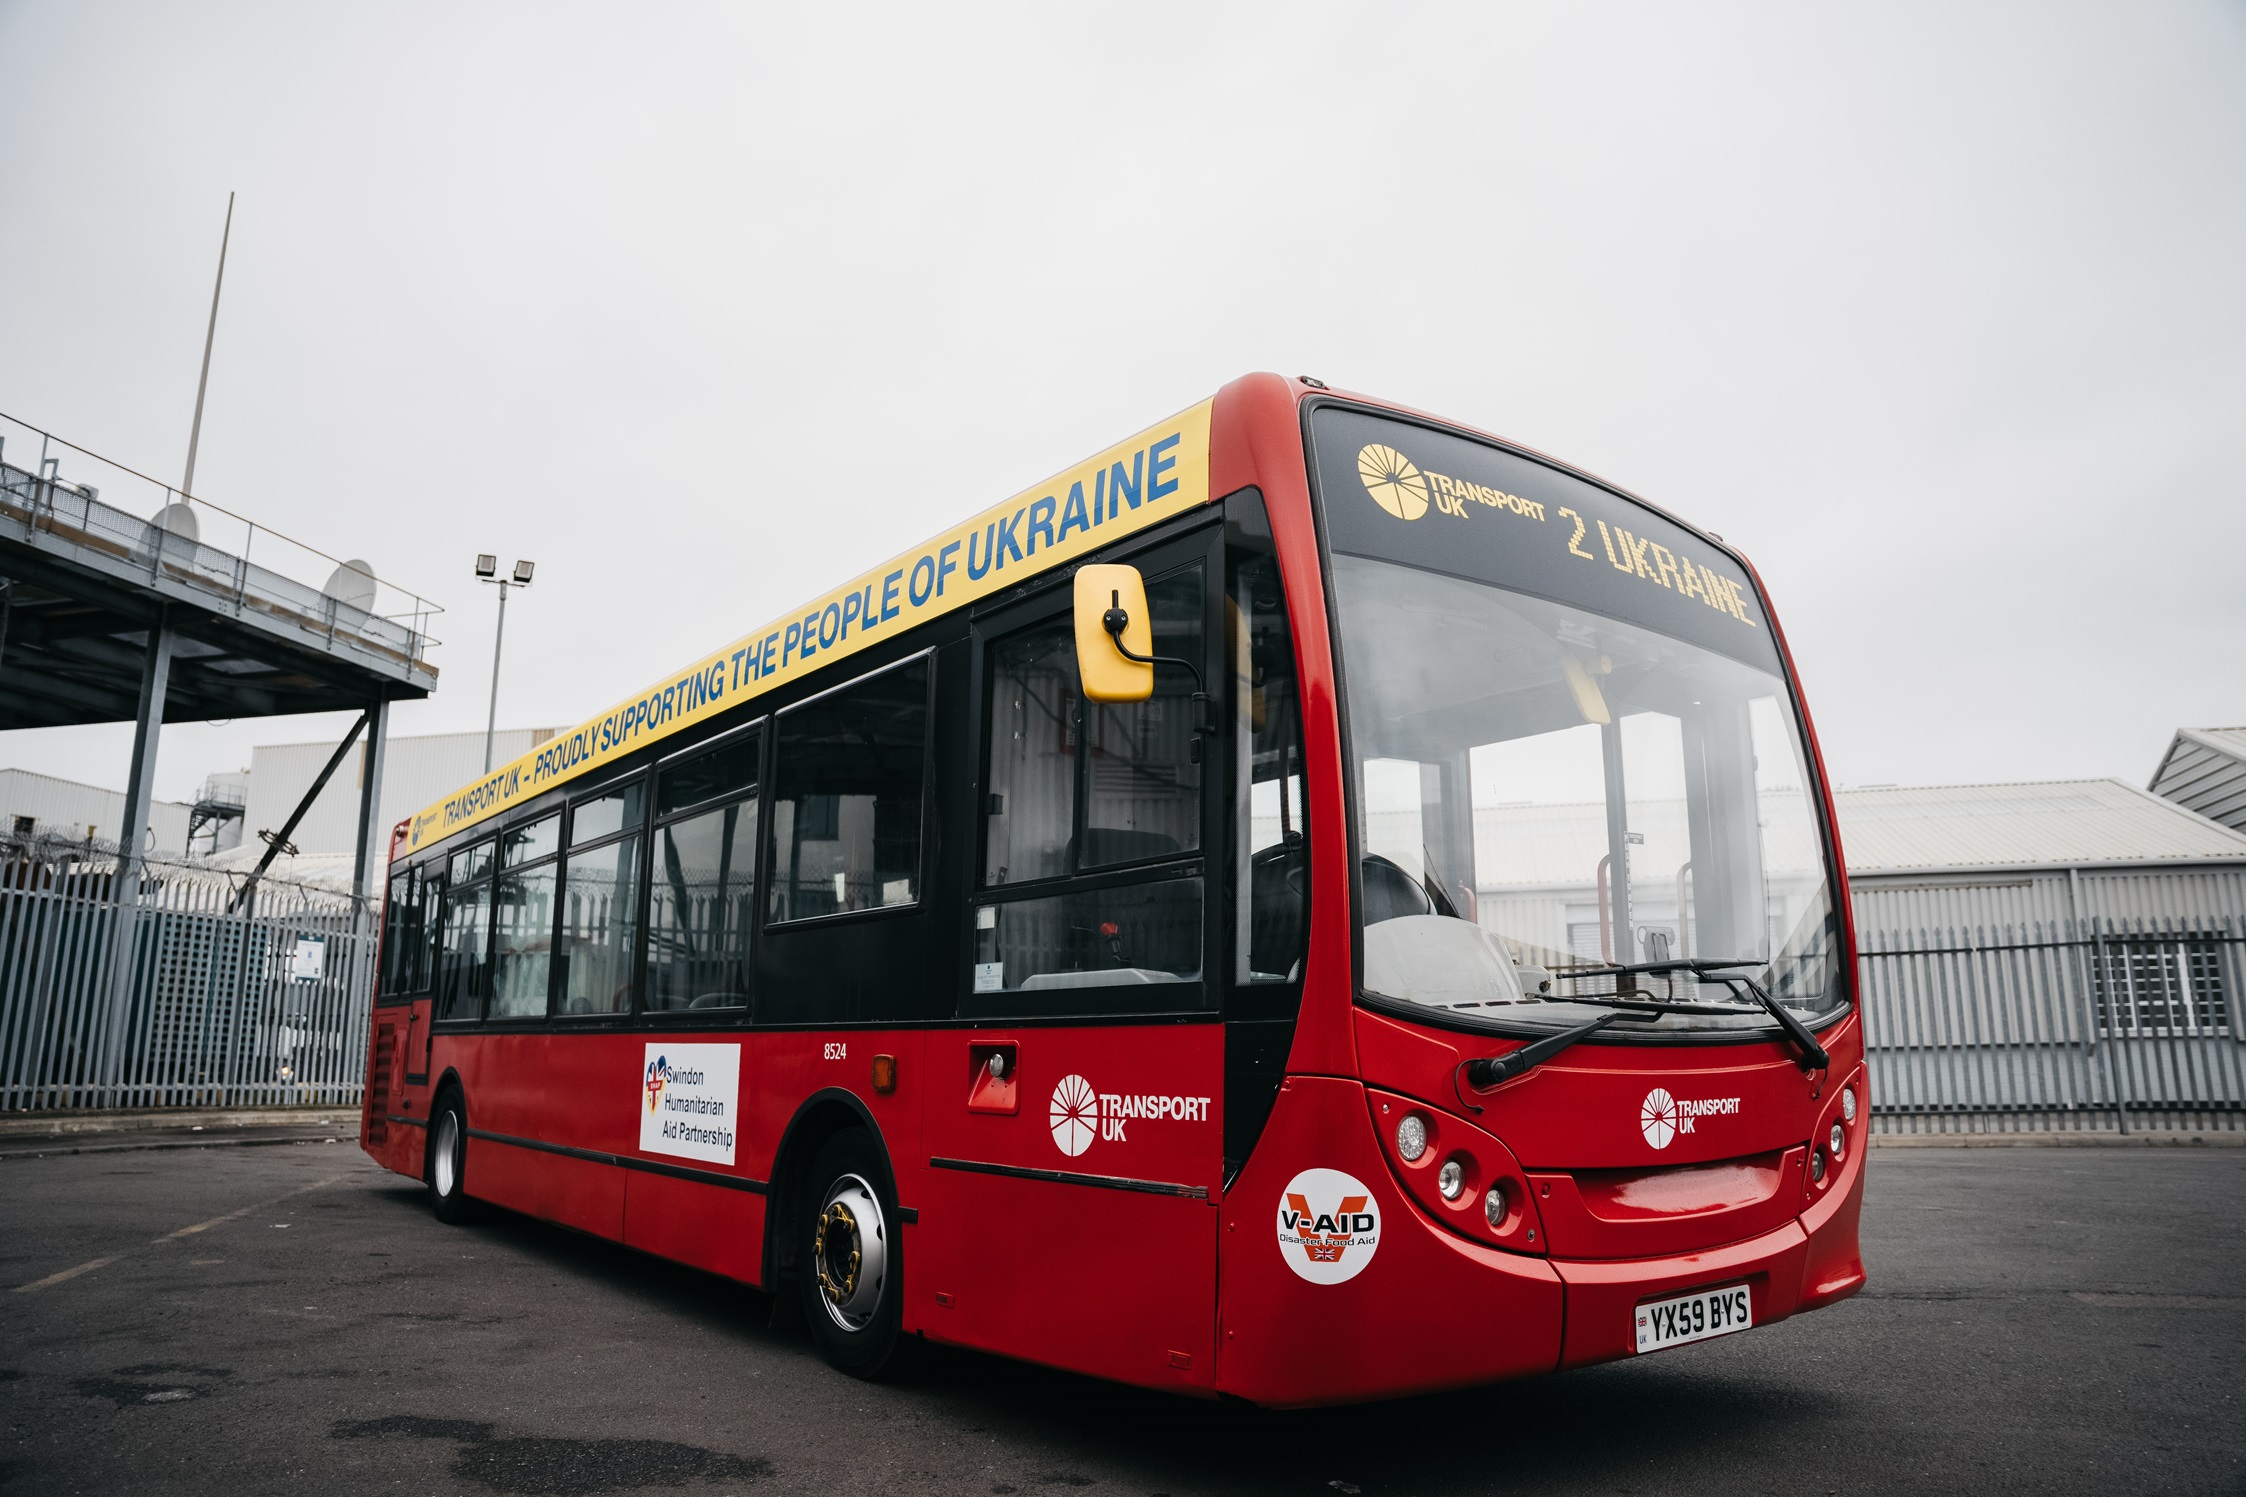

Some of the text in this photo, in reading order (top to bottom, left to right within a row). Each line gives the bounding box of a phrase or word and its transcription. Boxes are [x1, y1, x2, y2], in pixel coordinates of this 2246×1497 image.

[1423, 470, 1545, 521] TRANSPORT
[1434, 495, 1469, 519] UK
[1558, 507, 1757, 627] 2 UKRAINE
[443, 774, 504, 828] TRANSPORT
[504, 764, 523, 799] UK
[534, 722, 602, 784] PROUDLY
[600, 661, 725, 752] SUPPORTING
[732, 631, 779, 691] THE
[782, 568, 904, 668] PEOPLE
[909, 540, 961, 607] OF
[967, 432, 1181, 582] UKRAINE
[823, 1042, 847, 1060] 8524
[666, 1065, 704, 1086] Swindon
[664, 1092, 724, 1116] Humanitarian
[1099, 1094, 1211, 1122] TRANSPORT
[1677, 1097, 1741, 1117] TRANSPORT
[662, 1119, 733, 1152] Aid Partnership
[1102, 1118, 1127, 1142] UK
[1679, 1117, 1695, 1134] UK
[1281, 1210, 1375, 1233] V-AID
[1279, 1233, 1375, 1246] Disaster Food Aid
[1651, 1291, 1748, 1342] YX59 BYS
[1638, 1335, 1648, 1345] UK
